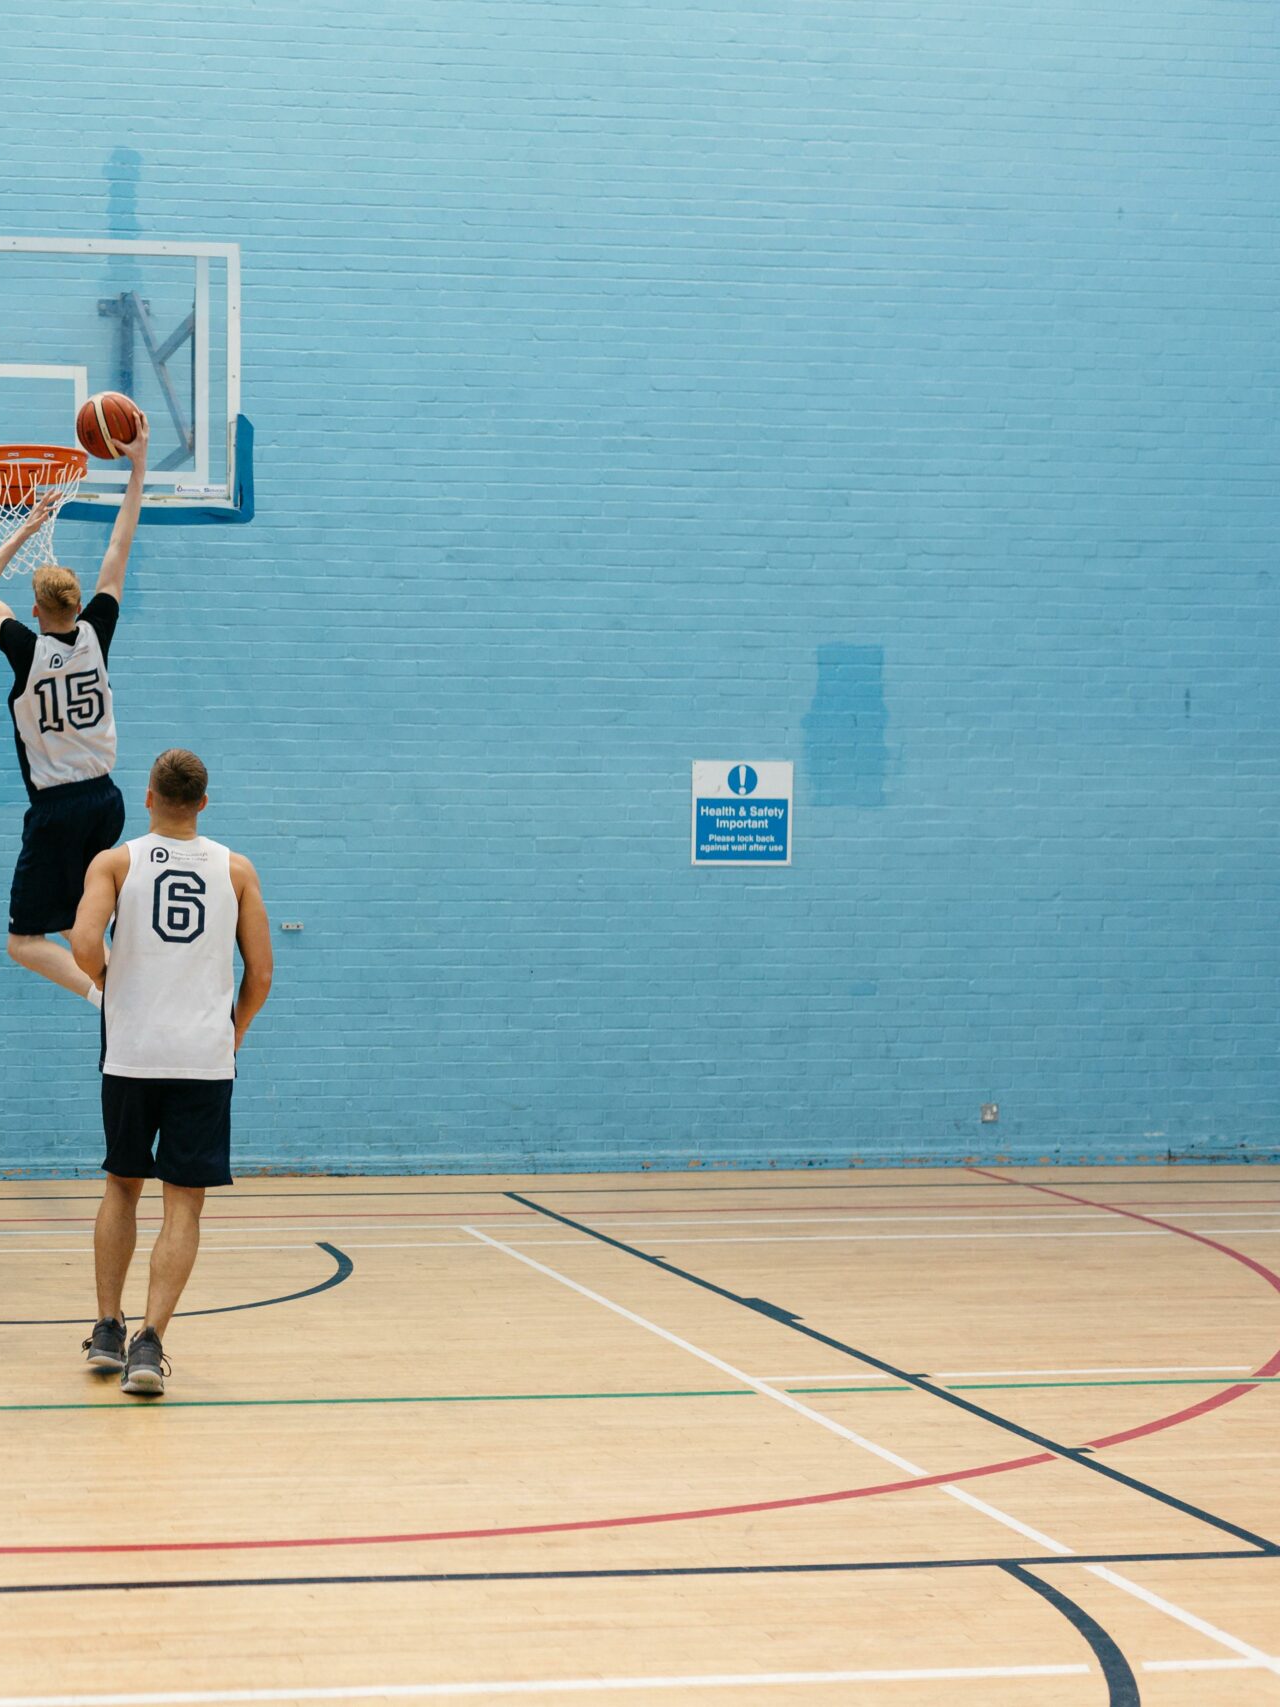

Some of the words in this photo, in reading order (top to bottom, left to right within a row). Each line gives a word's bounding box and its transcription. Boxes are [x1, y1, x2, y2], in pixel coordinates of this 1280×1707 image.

[34, 667, 104, 733] 15
[700, 806, 735, 816] Health
[739, 806, 746, 816] &
[750, 806, 784, 819] Safety
[716, 819, 768, 830] Important
[709, 834, 735, 842] Please
[738, 834, 753, 842] lock
[756, 834, 774, 842] back
[701, 843, 729, 852] against
[731, 843, 747, 851] wall
[749, 843, 766, 851] after
[152, 869, 206, 943] 6
